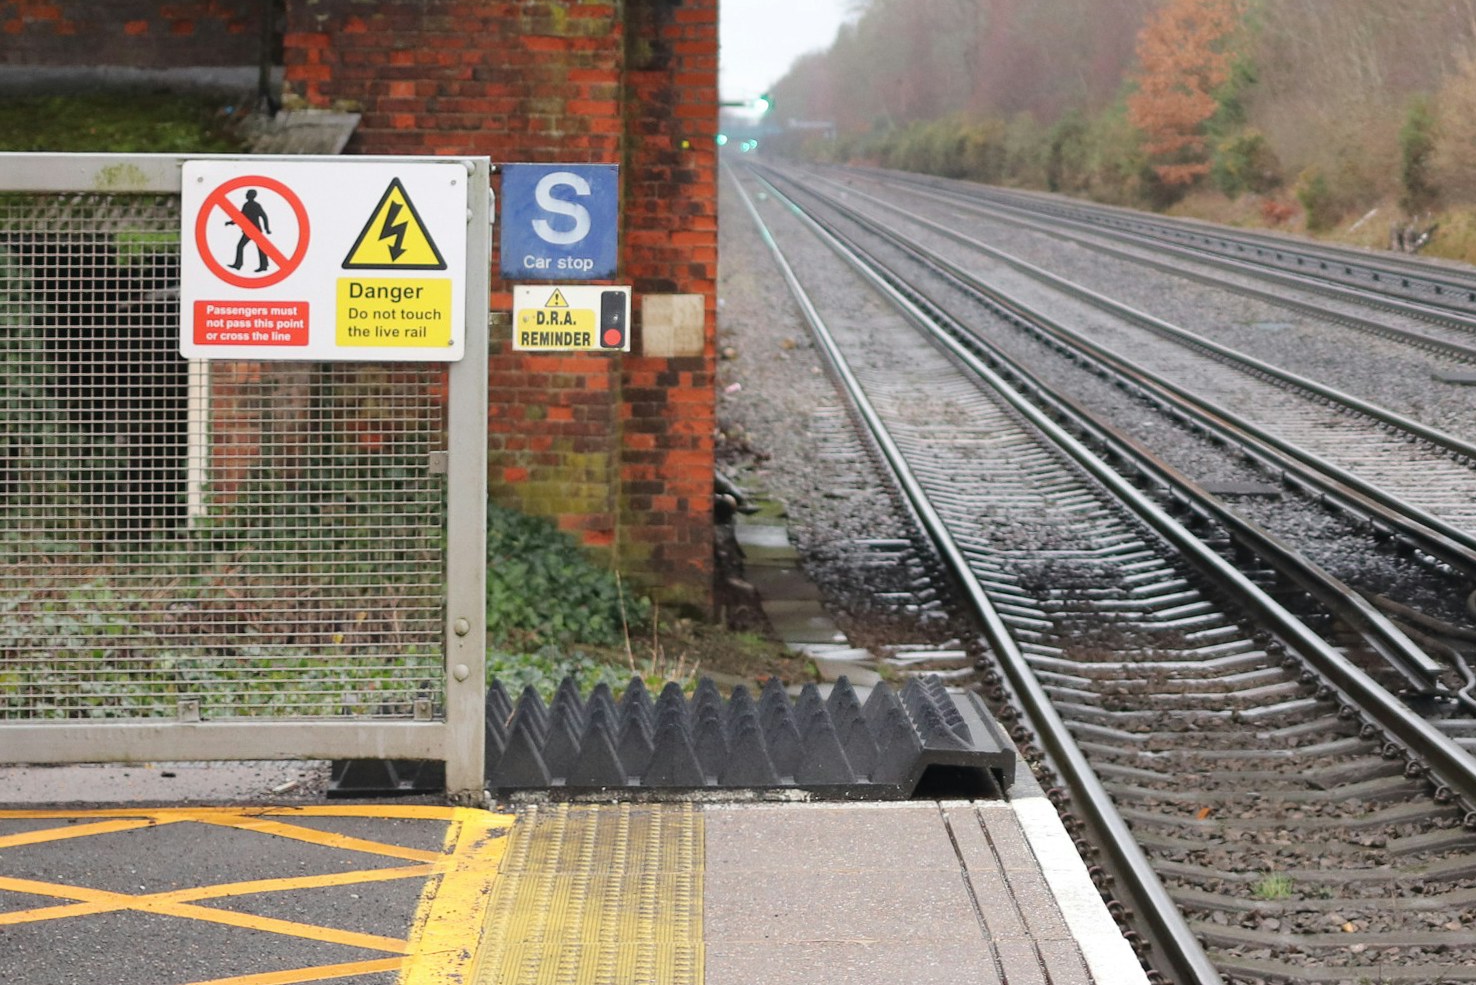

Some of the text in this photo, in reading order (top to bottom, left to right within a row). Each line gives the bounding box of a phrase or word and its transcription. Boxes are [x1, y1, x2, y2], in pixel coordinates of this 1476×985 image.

[532, 172, 591, 244] S
[523, 255, 593, 271] Car stop
[350, 282, 423, 303] Danger
[206, 305, 297, 317] Passengers must
[349, 308, 441, 320] Do not touch
[206, 319, 304, 330] not pass this point
[536, 311, 576, 325] D.R.A.
[206, 332, 291, 341] or cross the line
[348, 326, 426, 337] the live rail
[521, 332, 590, 346] REMINDER
